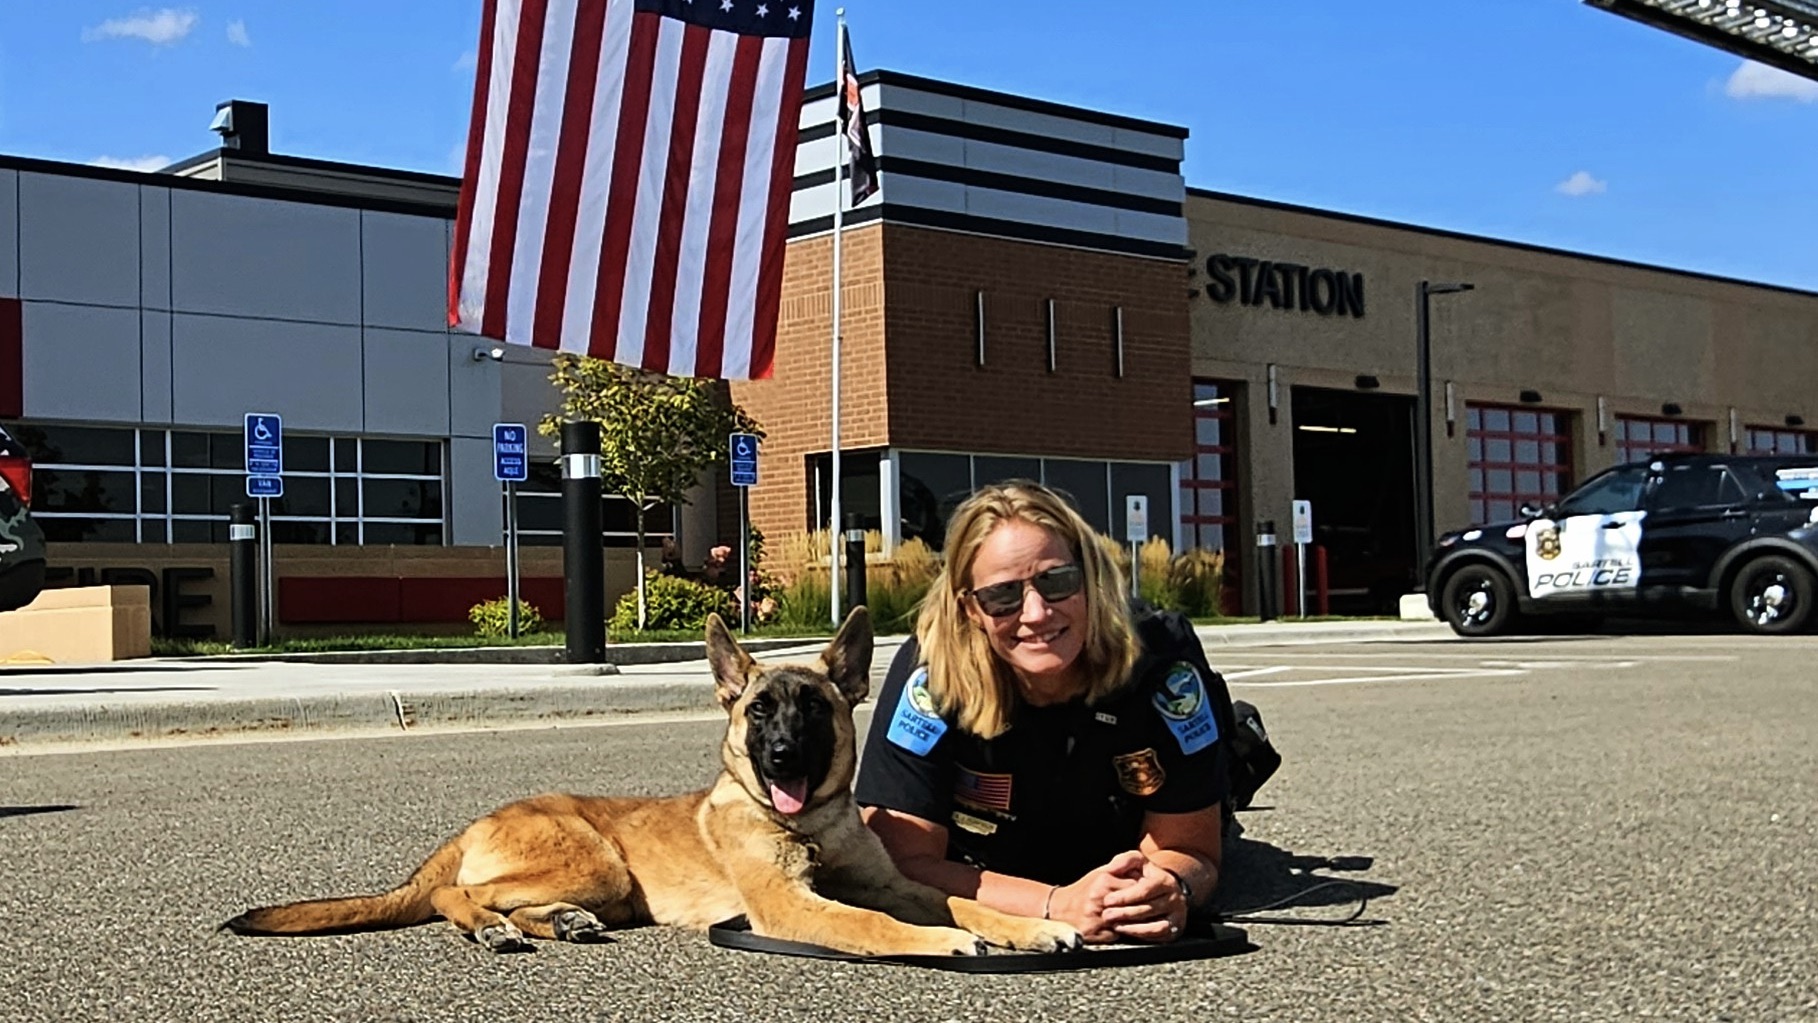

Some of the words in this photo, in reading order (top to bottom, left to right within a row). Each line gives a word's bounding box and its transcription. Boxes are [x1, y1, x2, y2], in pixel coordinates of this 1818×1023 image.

[1206, 253, 1365, 318] STATION
[504, 430, 516, 441] NO
[1535, 568, 1632, 590] POLICE
